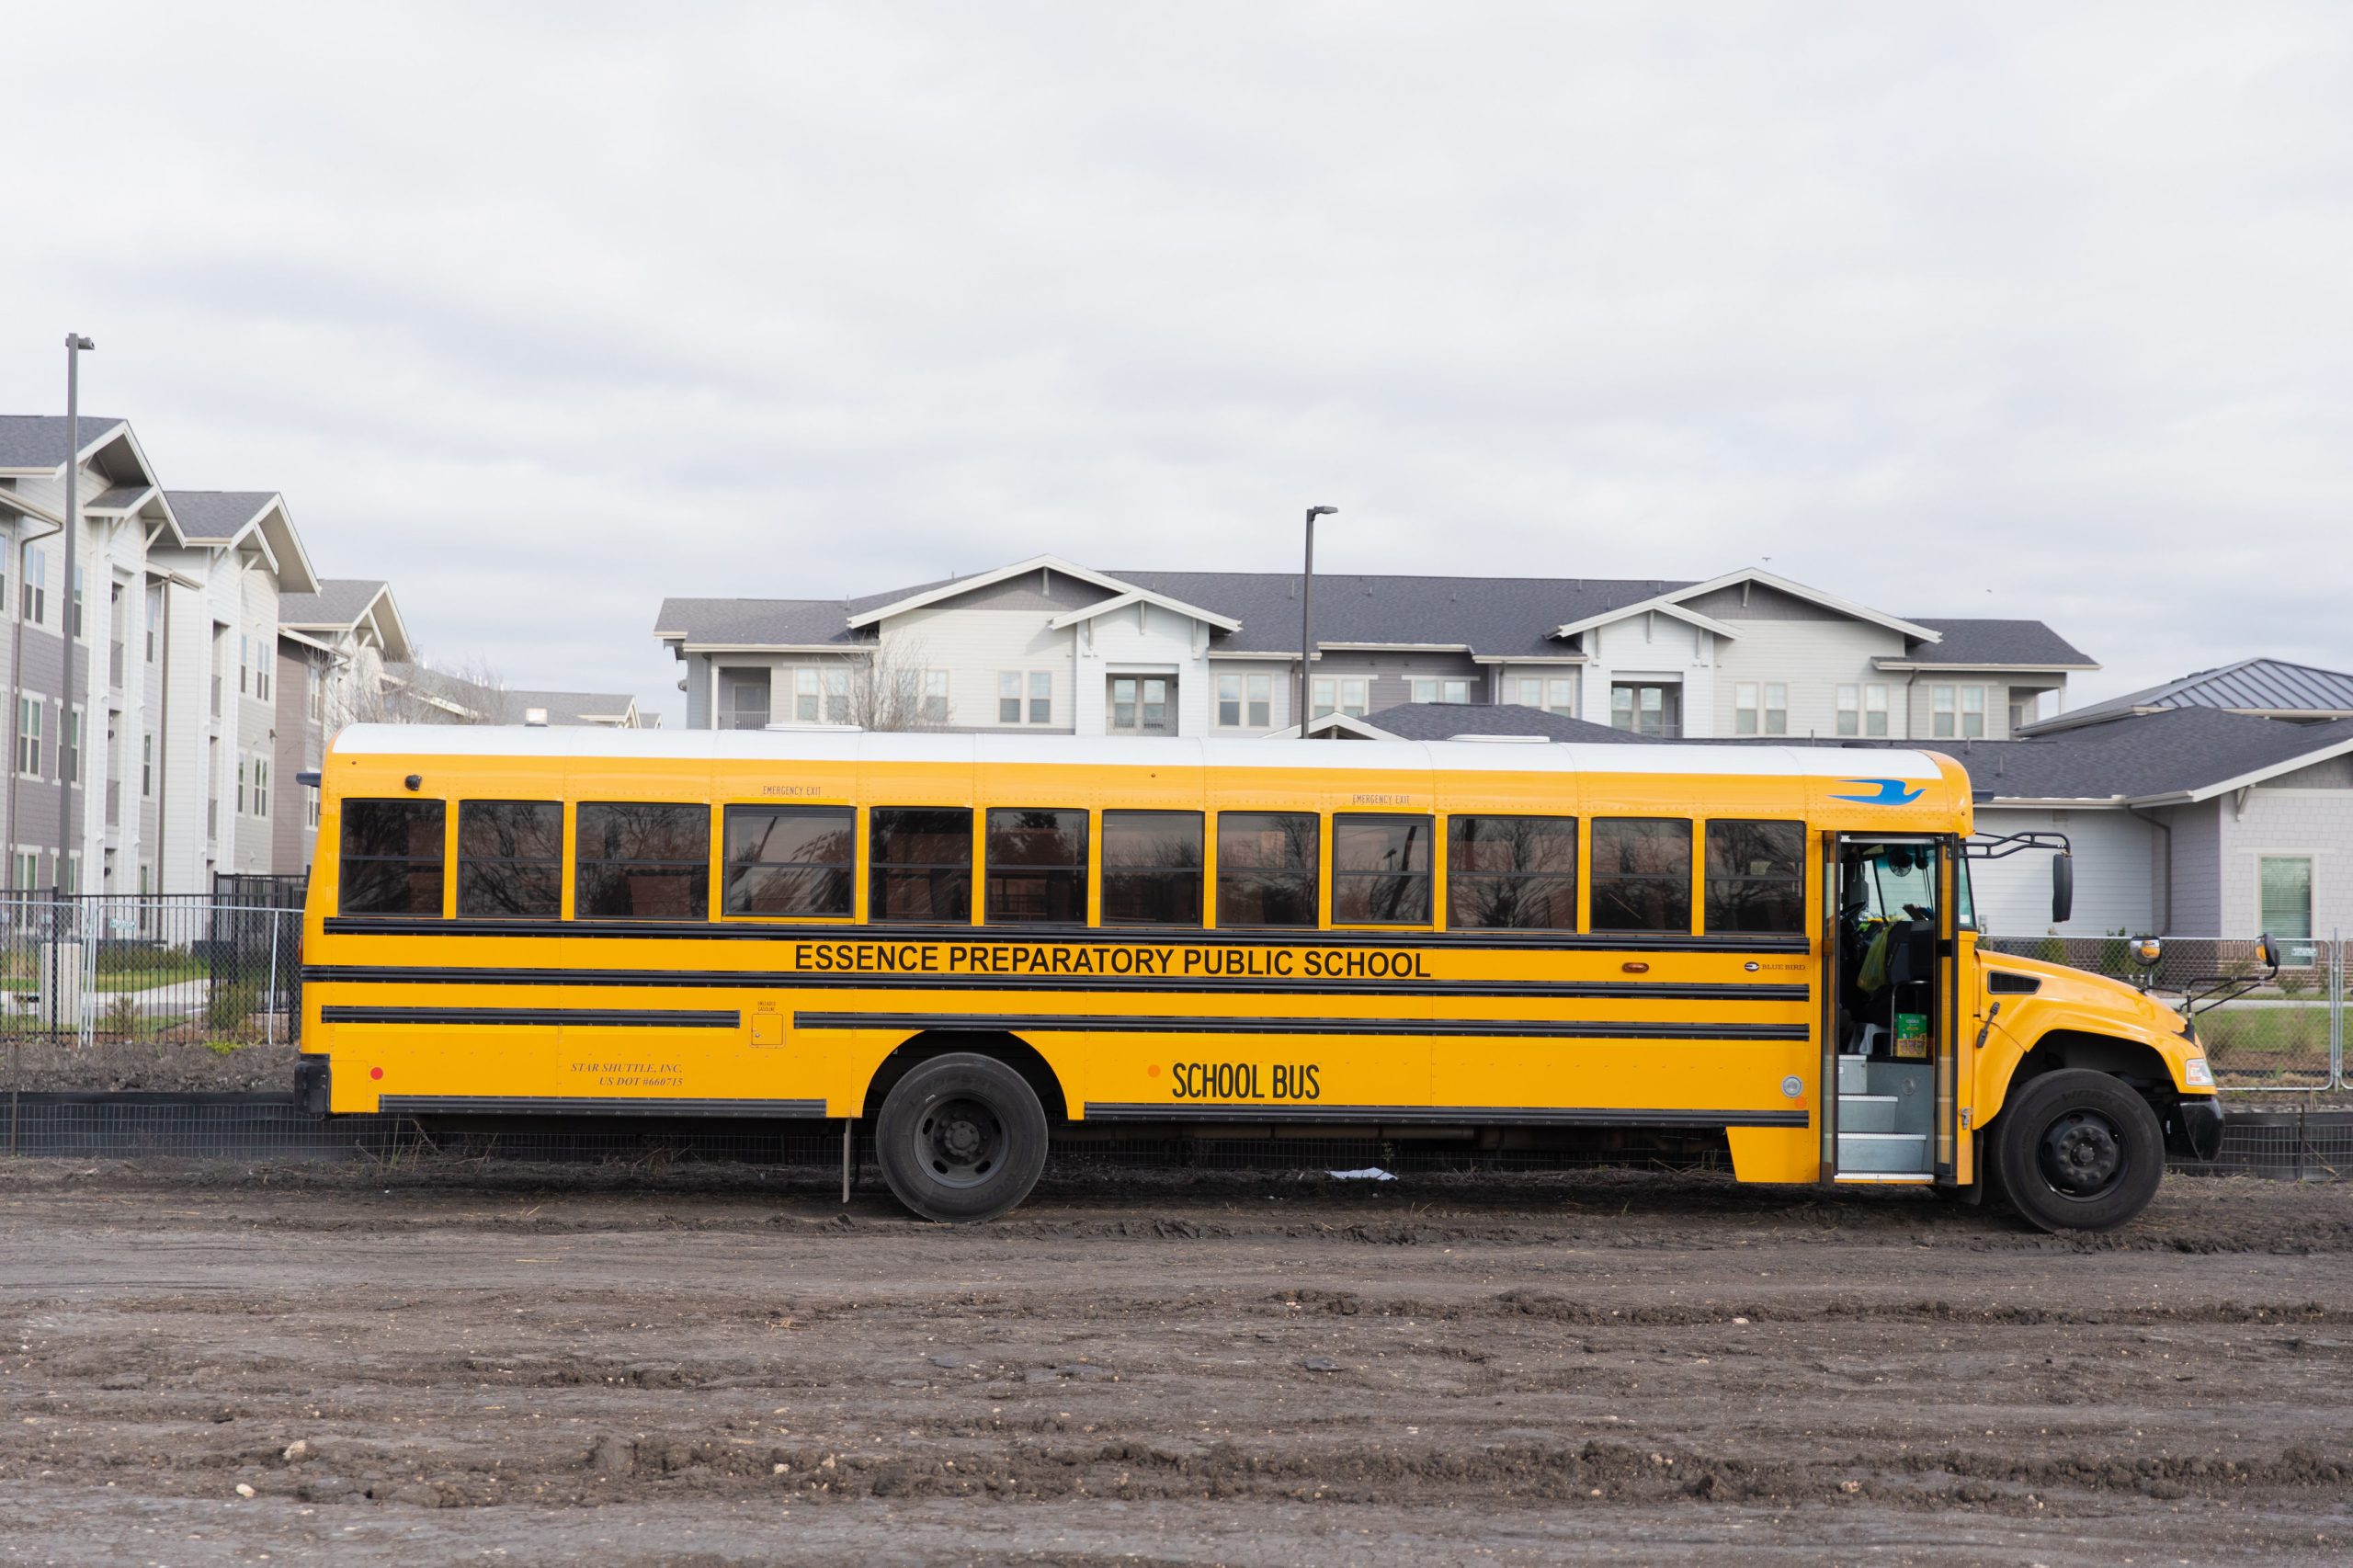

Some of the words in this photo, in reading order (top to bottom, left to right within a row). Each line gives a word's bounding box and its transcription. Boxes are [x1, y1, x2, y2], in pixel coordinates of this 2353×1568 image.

[763, 785, 803, 796] EMERGENCY
[806, 786, 821, 796] EXIT
[1352, 793, 1392, 804] EMERGENCY
[1395, 795, 1411, 804] EXIT
[795, 944, 938, 971] ESSENCE
[949, 946, 1175, 974] PREPARATORY
[1184, 949, 1294, 976] PUBLIC
[1303, 950, 1431, 978] SCHOOL
[570, 1062, 599, 1073] STAR
[601, 1063, 657, 1074] SHUTTLE,
[659, 1063, 683, 1074] INC.
[599, 1076, 614, 1086] US
[616, 1076, 641, 1086] DOT
[642, 1077, 684, 1087] #660715
[1172, 1062, 1266, 1098] SCHOOL
[1272, 1064, 1321, 1099] BUS
